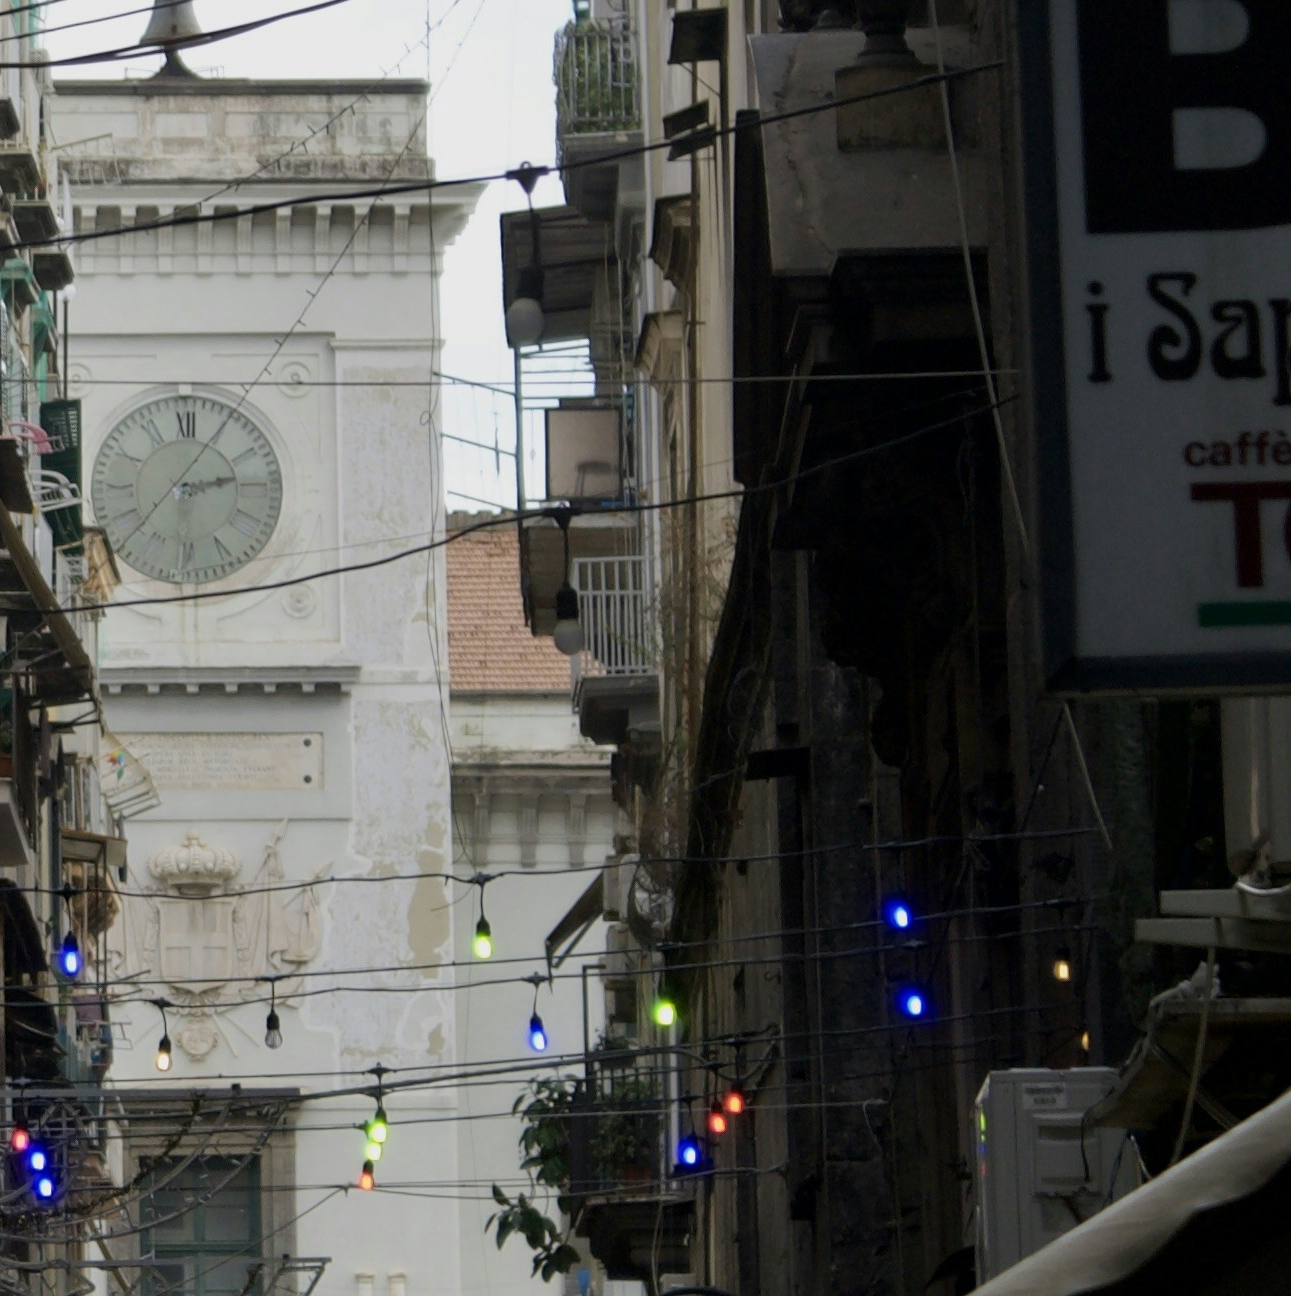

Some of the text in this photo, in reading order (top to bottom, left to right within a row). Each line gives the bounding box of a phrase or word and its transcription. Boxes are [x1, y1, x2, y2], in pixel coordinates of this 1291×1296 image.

[1085, 280, 1113, 383] i
[176, 411, 196, 439] XII
[1191, 481, 1291, 587] T
